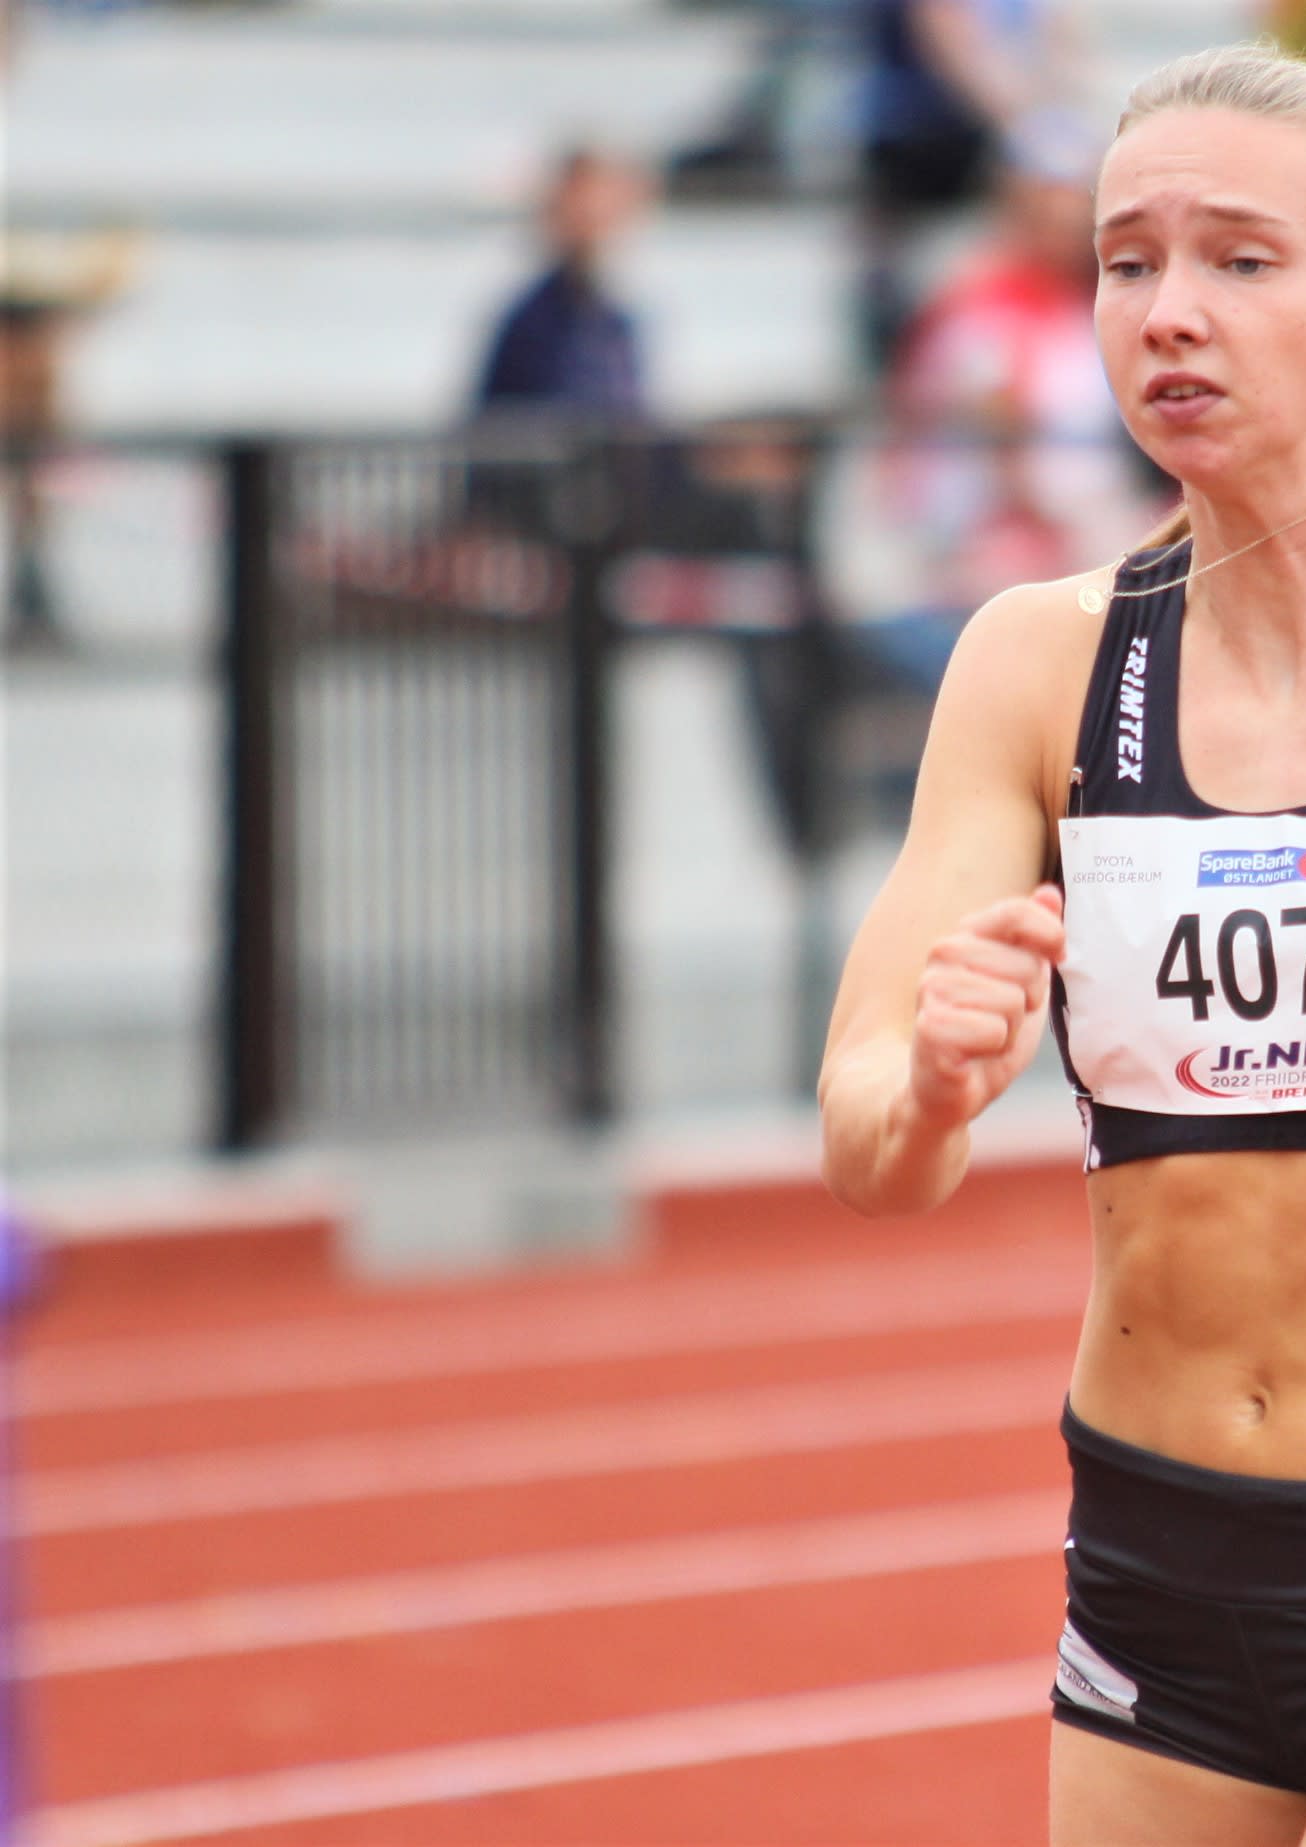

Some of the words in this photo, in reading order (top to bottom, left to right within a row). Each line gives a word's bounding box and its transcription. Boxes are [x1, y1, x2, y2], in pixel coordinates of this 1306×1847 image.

[1117, 636, 1149, 784] TRIMTEX
[1200, 849, 1295, 873] SpareBank
[1119, 871, 1162, 884] BÆRUM
[1223, 868, 1295, 884] ØSTLANDET
[1211, 1075, 1250, 1088] 2022
